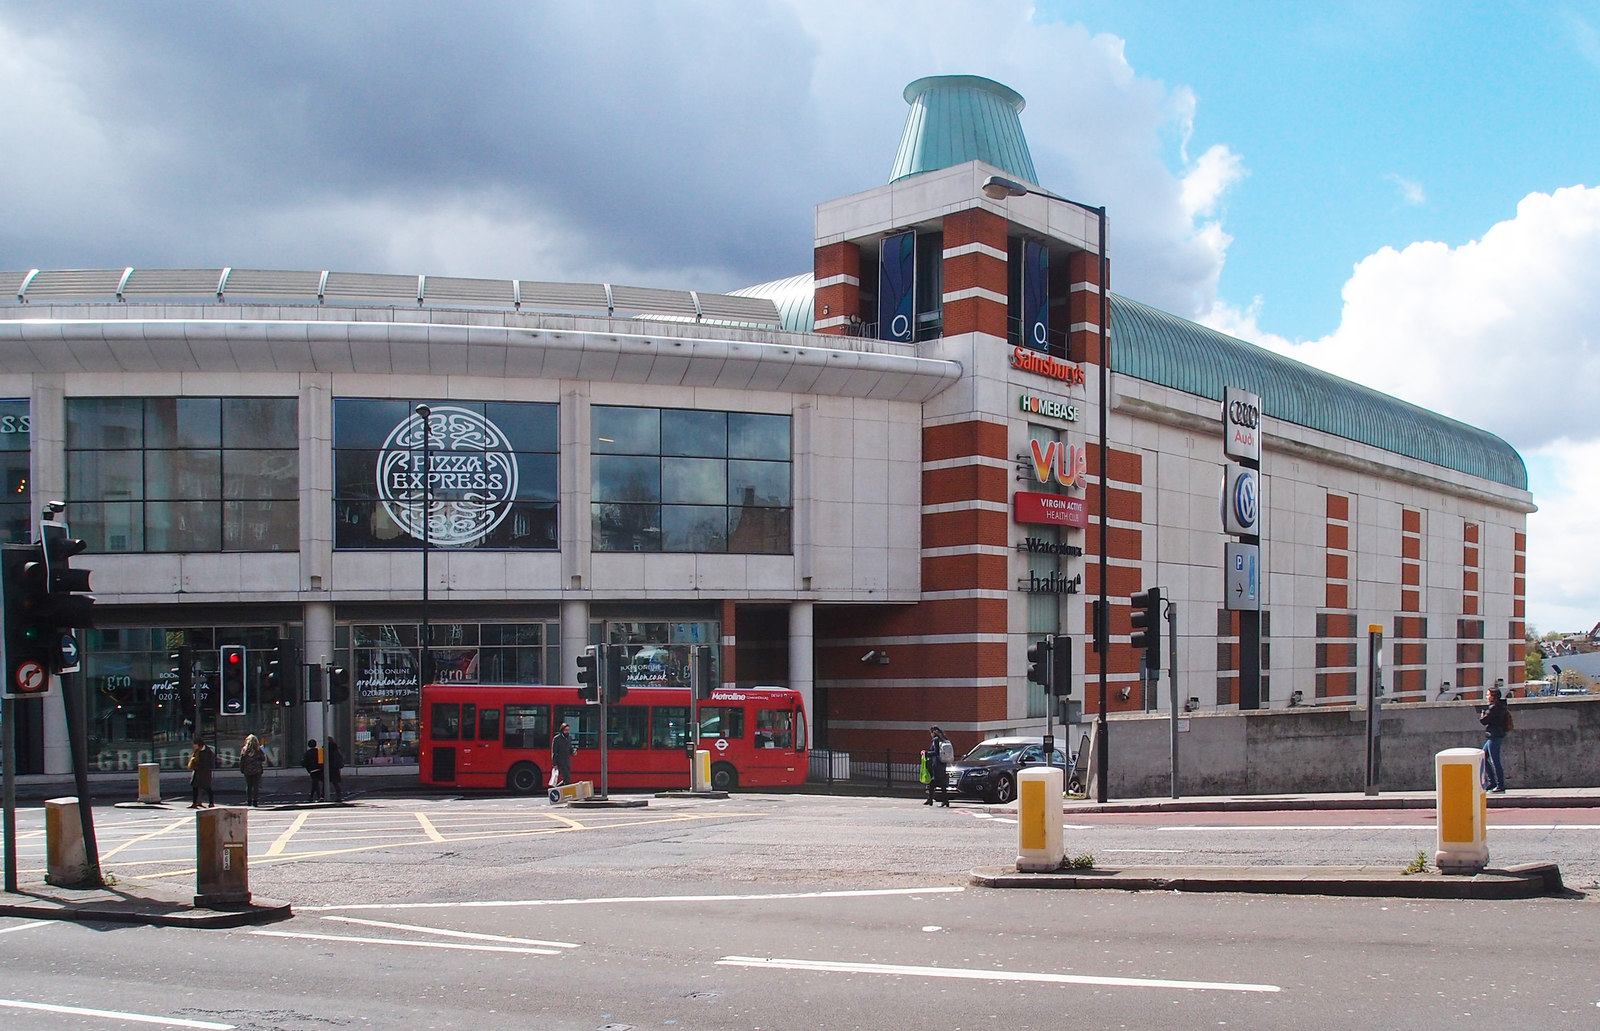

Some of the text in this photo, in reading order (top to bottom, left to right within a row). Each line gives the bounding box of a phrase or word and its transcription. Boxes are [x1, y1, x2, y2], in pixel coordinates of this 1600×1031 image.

[1012, 346, 1086, 387] Sainsbury's
[1022, 394, 1080, 422] HOMEBASE
[1234, 429, 1255, 447] Audi
[412, 455, 484, 472] PIZZA
[392, 472, 503, 490] EXPRESS
[1040, 498, 1083, 512] VIRGIN ACTIVE
[1046, 510, 1068, 521] HEALTH
[1028, 569, 1079, 594] habitat
[356, 675, 418, 691] grolondon.co.uk
[440, 668, 463, 684] gro
[712, 692, 746, 701] Metroline
